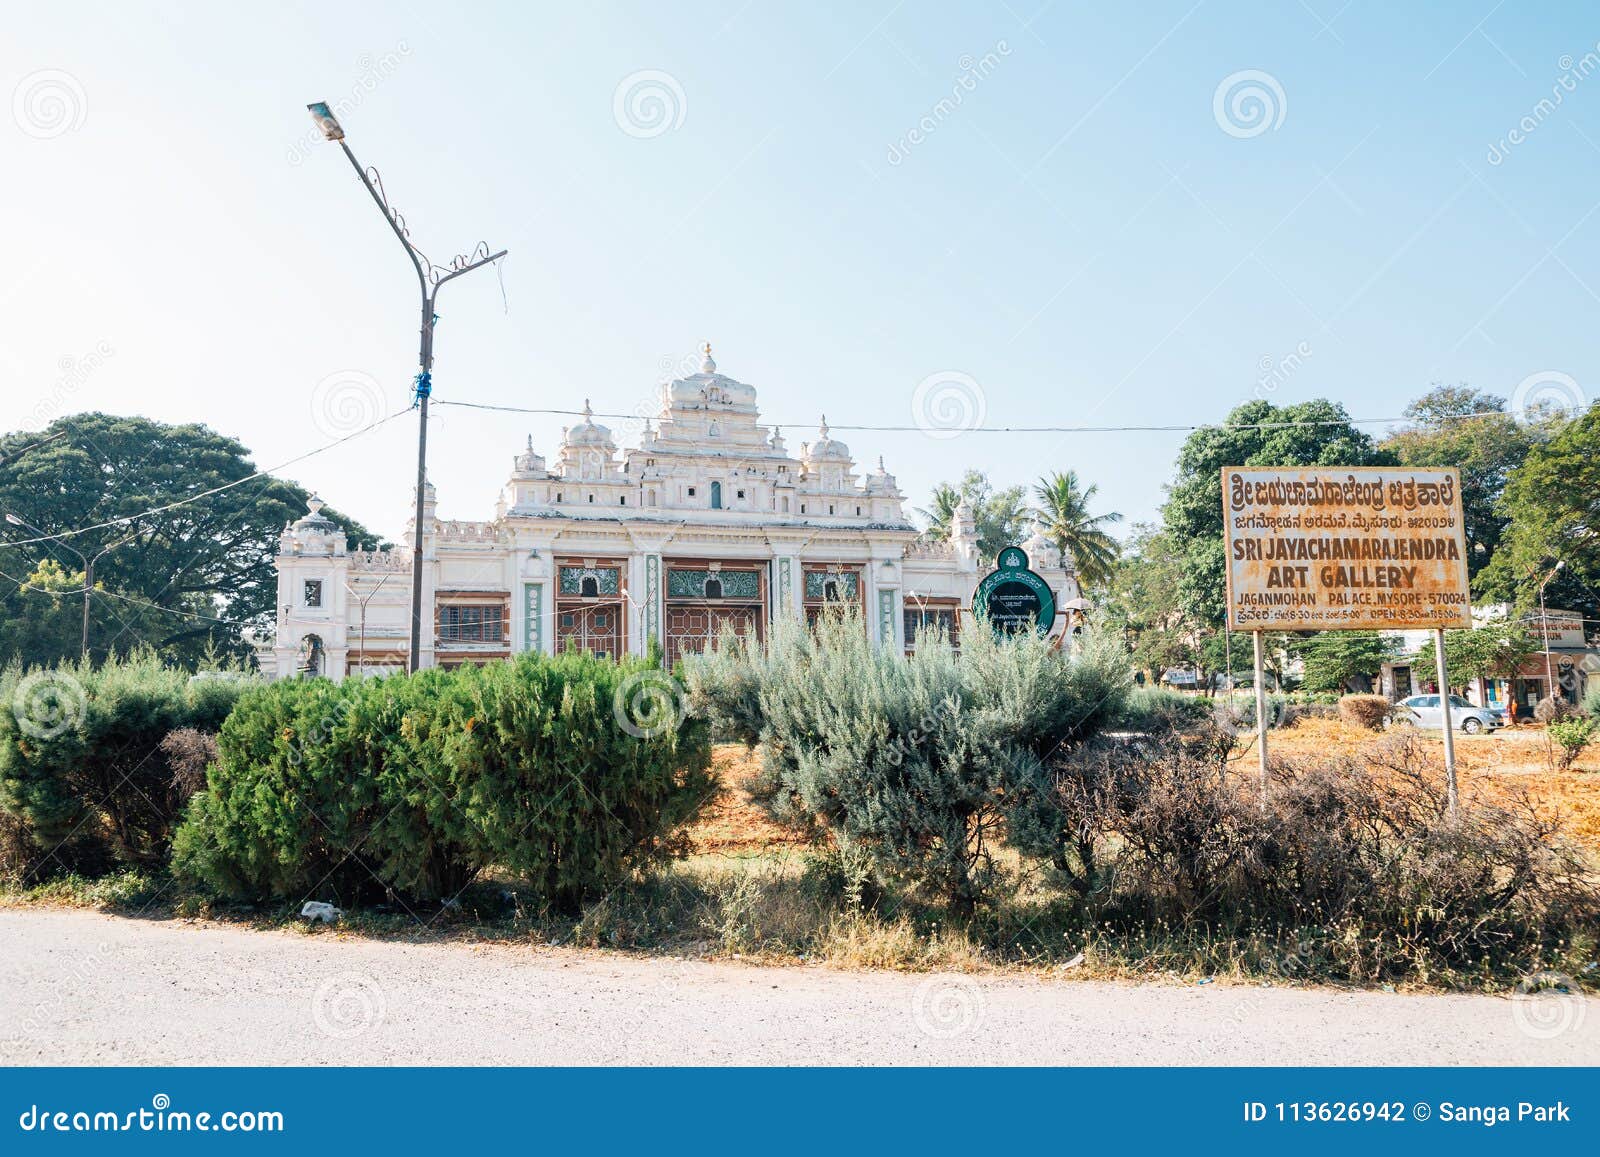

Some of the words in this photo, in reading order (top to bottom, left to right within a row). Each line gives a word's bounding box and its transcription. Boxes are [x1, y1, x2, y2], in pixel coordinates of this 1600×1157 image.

[1233, 538, 1262, 561] SRI
[1265, 538, 1460, 561] JAYACHAMARAJENDRA
[1266, 566, 1309, 589] ART
[1320, 566, 1417, 589] GALLERY
[1237, 592, 1316, 606] JAGANMOHAN
